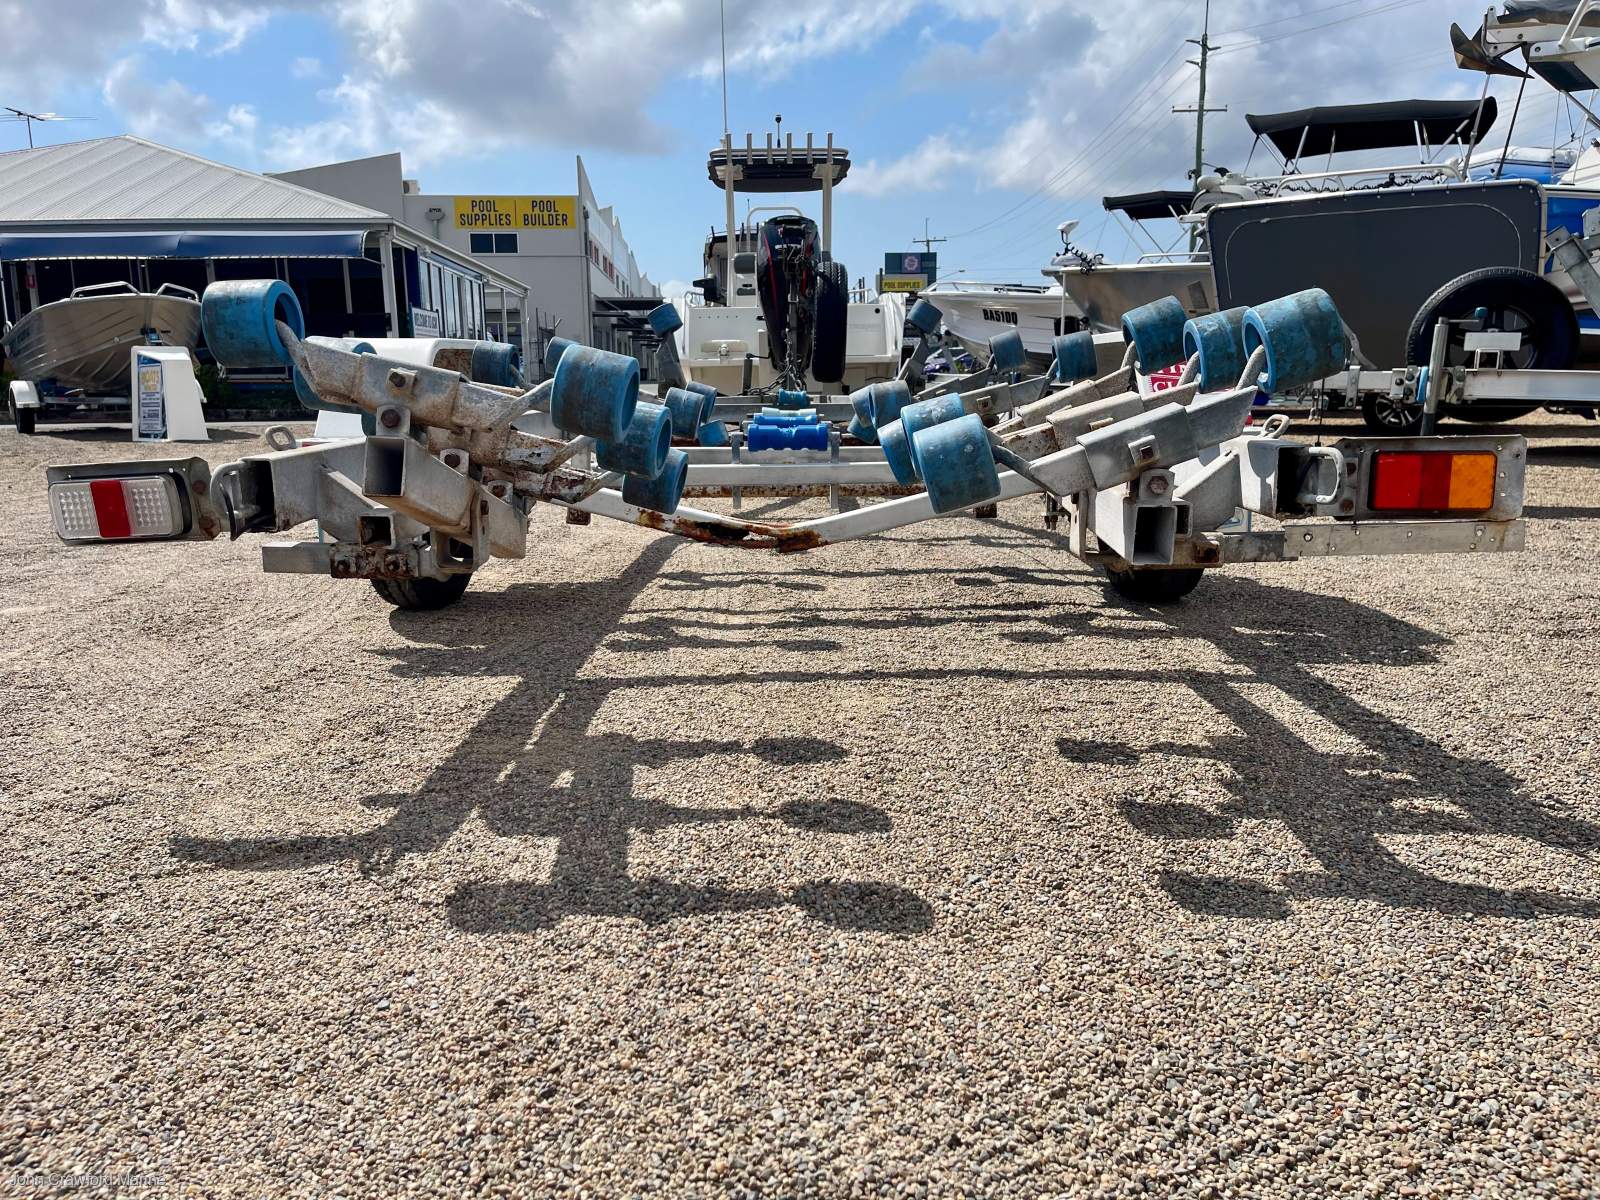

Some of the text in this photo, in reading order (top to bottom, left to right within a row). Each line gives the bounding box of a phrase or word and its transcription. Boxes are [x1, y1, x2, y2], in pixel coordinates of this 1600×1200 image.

[471, 200, 499, 212] POOL
[531, 200, 559, 212] POOL
[460, 213, 512, 226] SUPPLIES
[523, 213, 568, 226] BUILDER
